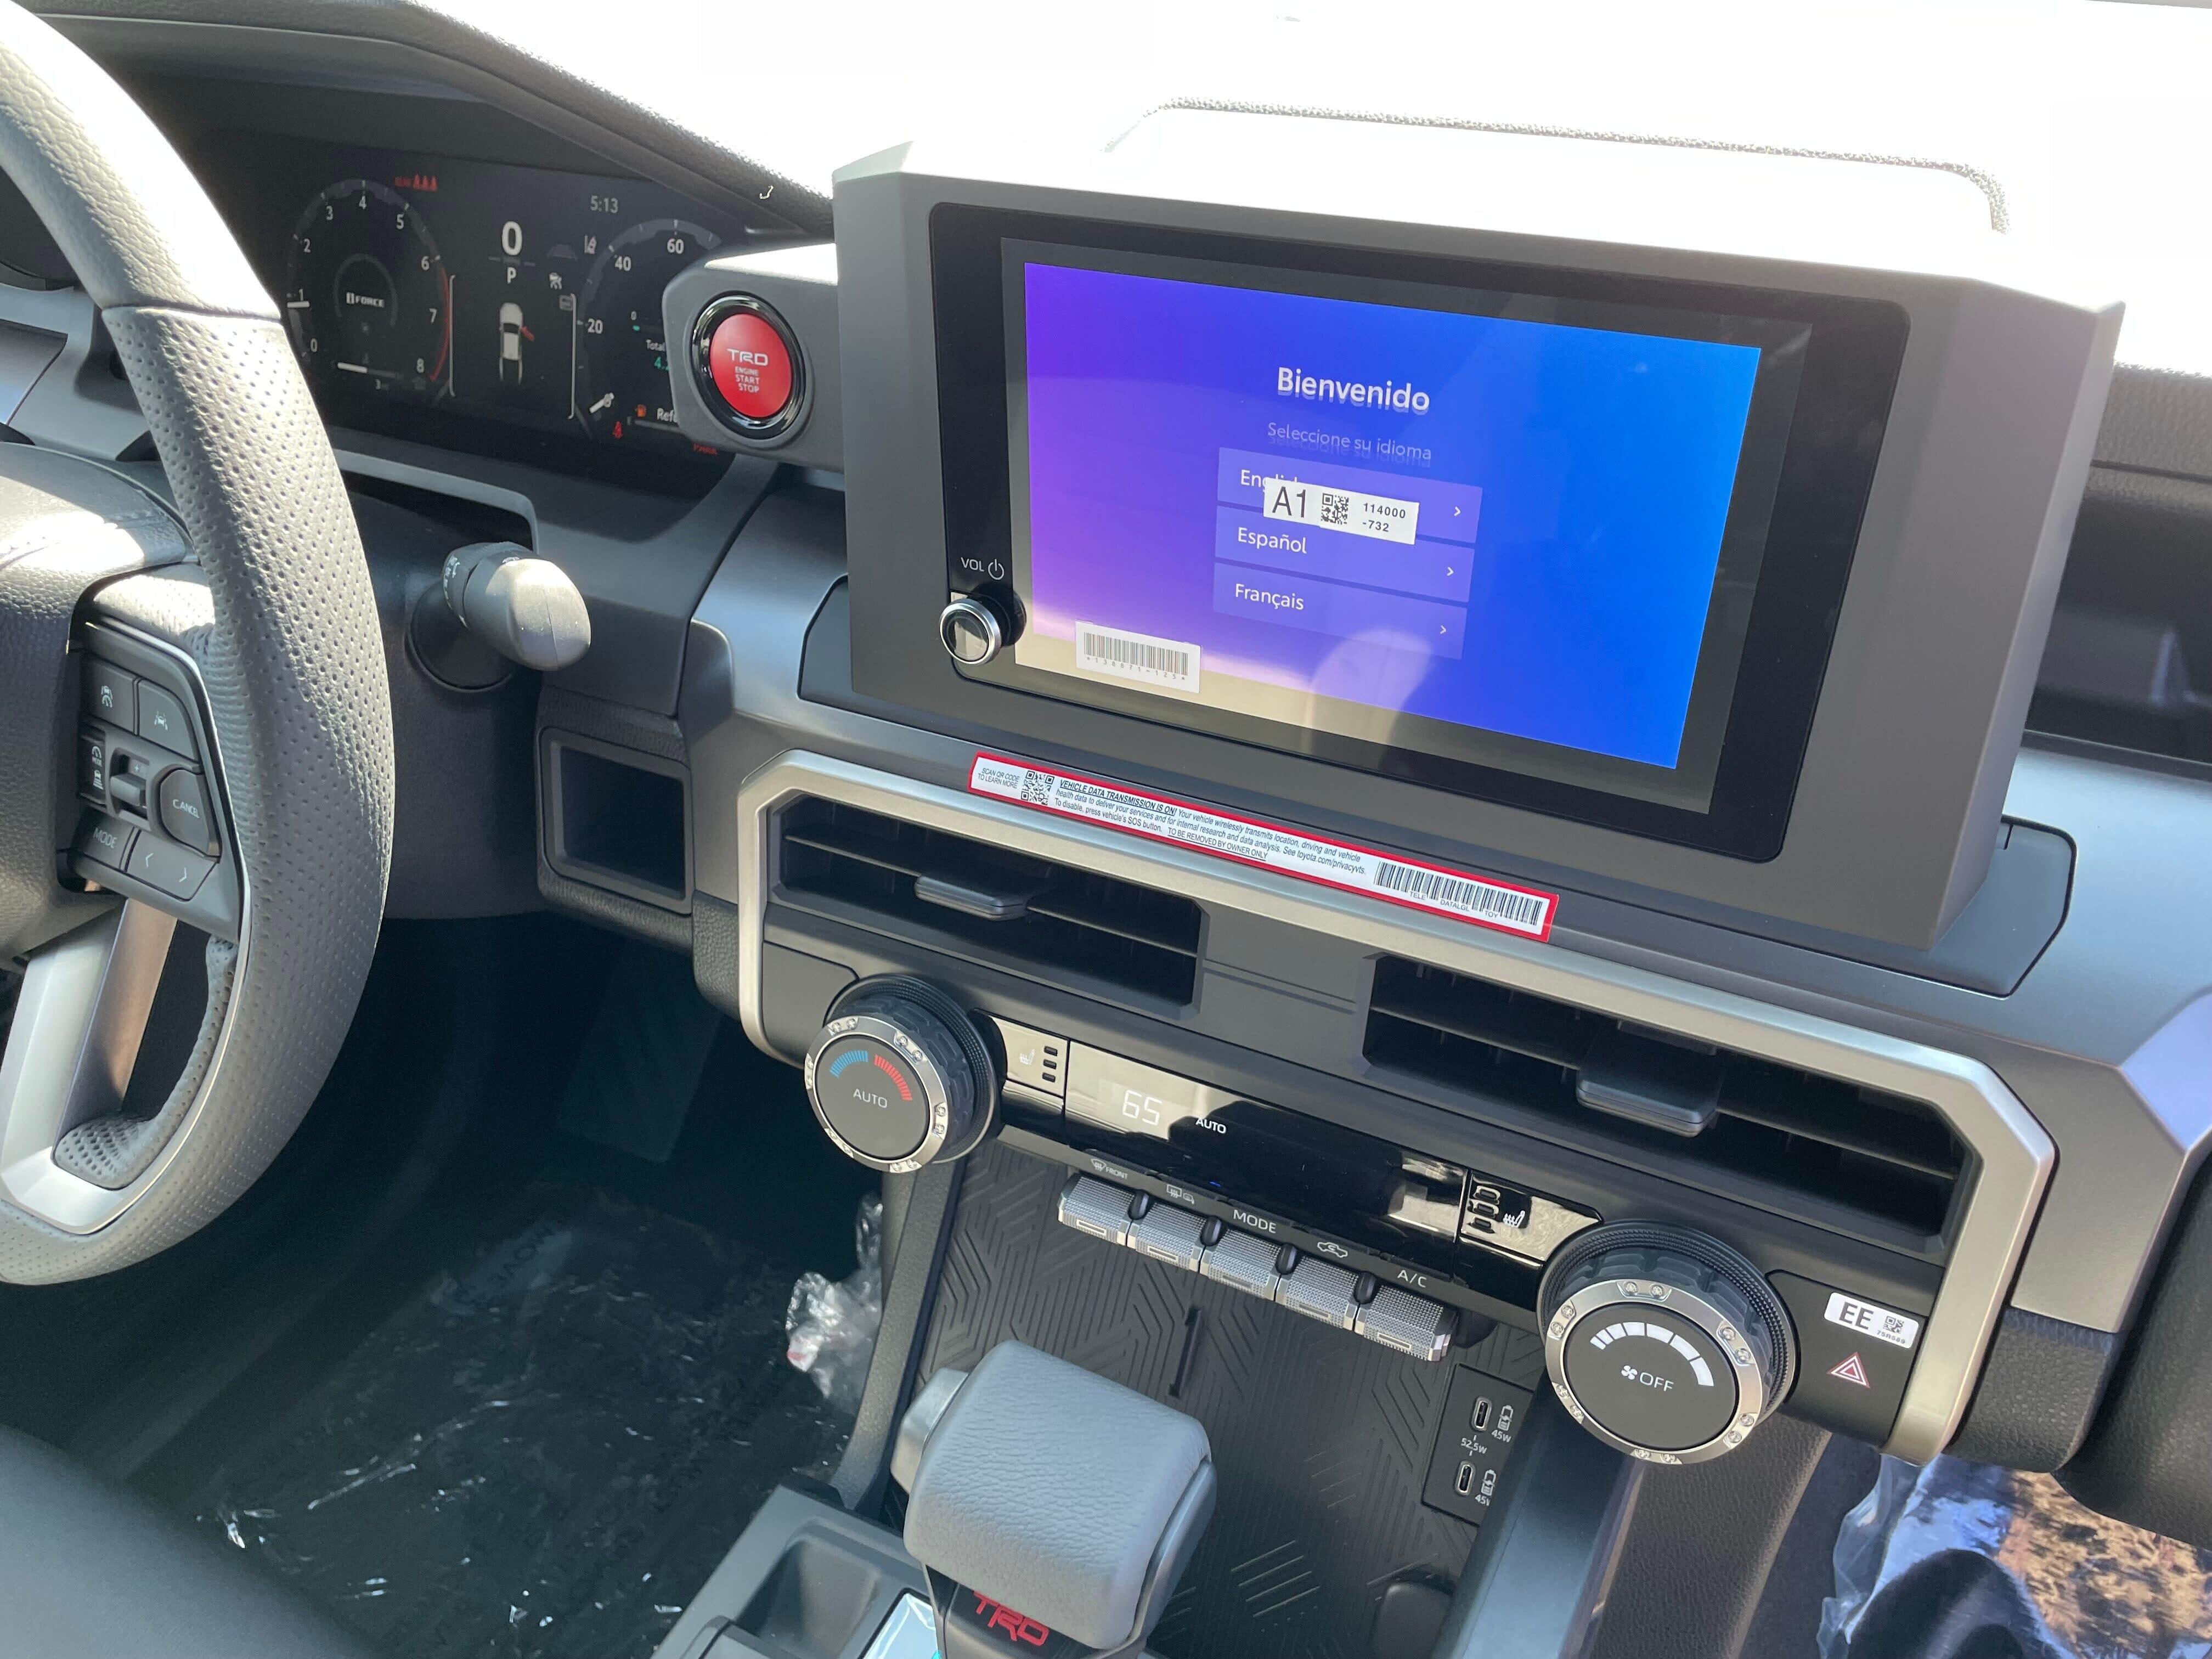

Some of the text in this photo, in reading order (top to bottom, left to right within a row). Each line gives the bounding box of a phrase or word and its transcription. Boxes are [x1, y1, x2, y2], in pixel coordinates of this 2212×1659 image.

[359, 195, 367, 210] 4
[590, 195, 619, 213] 5:13
[326, 205, 334, 221] 3
[396, 214, 404, 230] 5
[303, 238, 311, 253] 2
[501, 221, 523, 256] 0
[667, 239, 685, 255] 60
[421, 256, 430, 270] 6
[614, 256, 632, 272] 40
[507, 267, 517, 284] P
[428, 308, 438, 324] 7
[588, 318, 603, 334] 20
[310, 338, 318, 353] 0
[726, 348, 769, 366] TRD
[416, 358, 425, 374] 8
[735, 366, 759, 377] ENGINE
[735, 374, 760, 385] START
[738, 383, 760, 393] STOP
[1277, 366, 1430, 411] Bienvenido
[1267, 422, 1432, 460] Seleccione su idioma
[1272, 486, 1306, 518] A1
[1363, 502, 1407, 519] 114000
[1363, 520, 1390, 533] -732
[1238, 527, 1307, 554] Español
[961, 557, 985, 572] VOL
[1235, 583, 1305, 611] Français
[982, 768, 996, 776] SCAN
[1005, 774, 1020, 782] CODE
[985, 775, 1002, 785] LEARN
[1002, 780, 1018, 789] MORE
[172, 798, 200, 819] CANCEL
[1054, 797, 1062, 806] To
[1085, 807, 1101, 817] press
[1102, 811, 1126, 823] vehicle's
[1127, 816, 1142, 827] SOS
[1143, 820, 1163, 832] button.
[1168, 827, 1177, 835] TO
[1177, 830, 1186, 838] BE
[1186, 832, 1217, 846] REMOVED
[1227, 843, 1250, 854] OWNER
[1251, 849, 1268, 859] ONLY
[1056, 788, 1074, 799] health
[1074, 793, 1087, 803] data
[1096, 798, 1115, 810] deliver
[1115, 804, 1130, 813] your
[1129, 808, 1154, 820] services
[1154, 814, 1167, 823] and
[1167, 816, 1176, 825] for
[1176, 818, 1199, 831] internal
[1199, 826, 1226, 838] research
[1227, 833, 1240, 842] and
[1240, 835, 1254, 845] data
[1283, 846, 1296, 856] See
[1060, 779, 1361, 862] VEHICLE DATA TRANSMISSION IS ON! Your vehicle wirelessly transmits location, driving and vehicle
[93, 827, 117, 849] MODE
[1409, 891, 1427, 901] TELE
[1484, 910, 1499, 918] TOY
[853, 1088, 888, 1109] AUTO
[1122, 1089, 1163, 1126] 65
[1195, 1117, 1227, 1134] AUTO
[1105, 1166, 1128, 1180] FRONT
[1232, 1209, 1277, 1234] MODE
[1397, 1269, 1427, 1289] A/C
[1838, 1301, 1874, 1330] EE
[1639, 1372, 1675, 1393] OFF
[1491, 1429, 1511, 1443] 45W
[973, 1590, 1050, 1646] TRD
